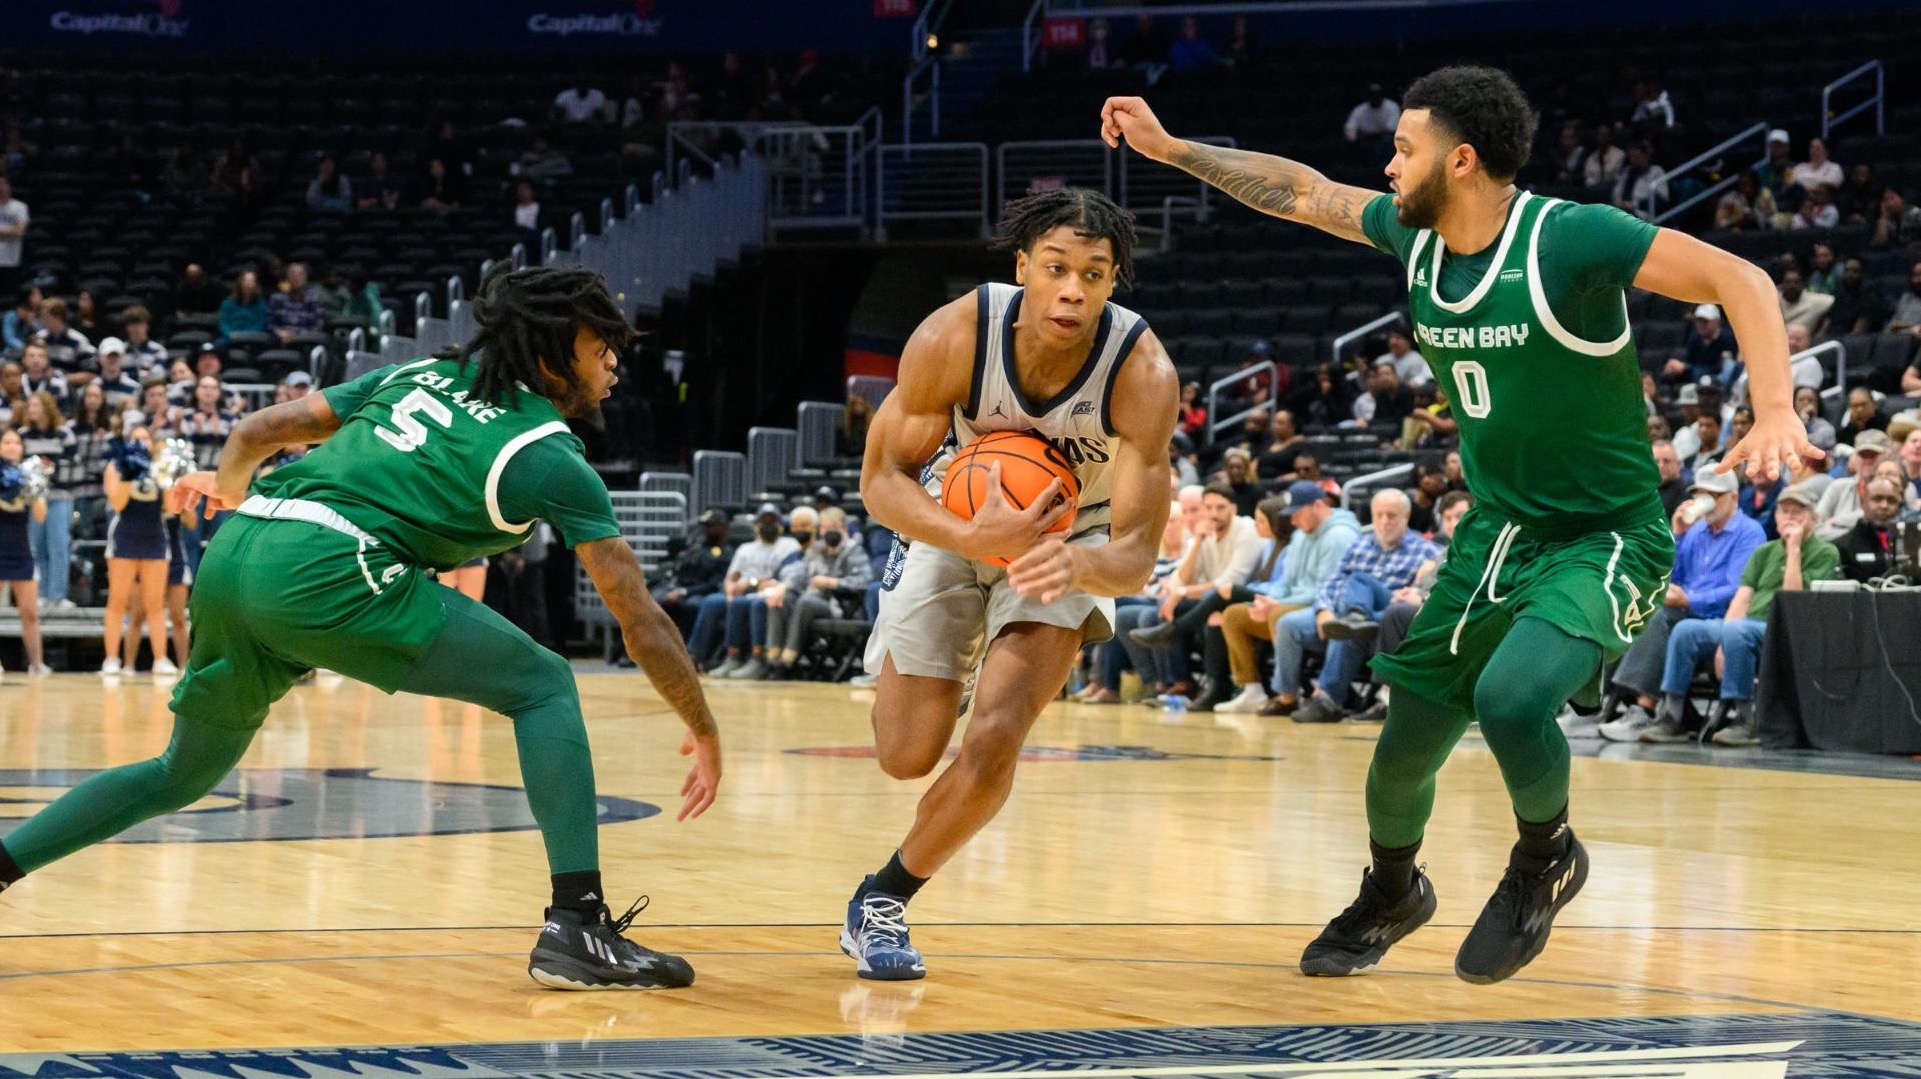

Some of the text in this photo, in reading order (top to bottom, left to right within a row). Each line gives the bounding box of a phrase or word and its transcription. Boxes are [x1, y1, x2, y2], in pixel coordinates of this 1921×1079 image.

[1413, 321, 1529, 348] REEN BAY
[1451, 360, 1492, 418] 0
[373, 386, 453, 452] 5
